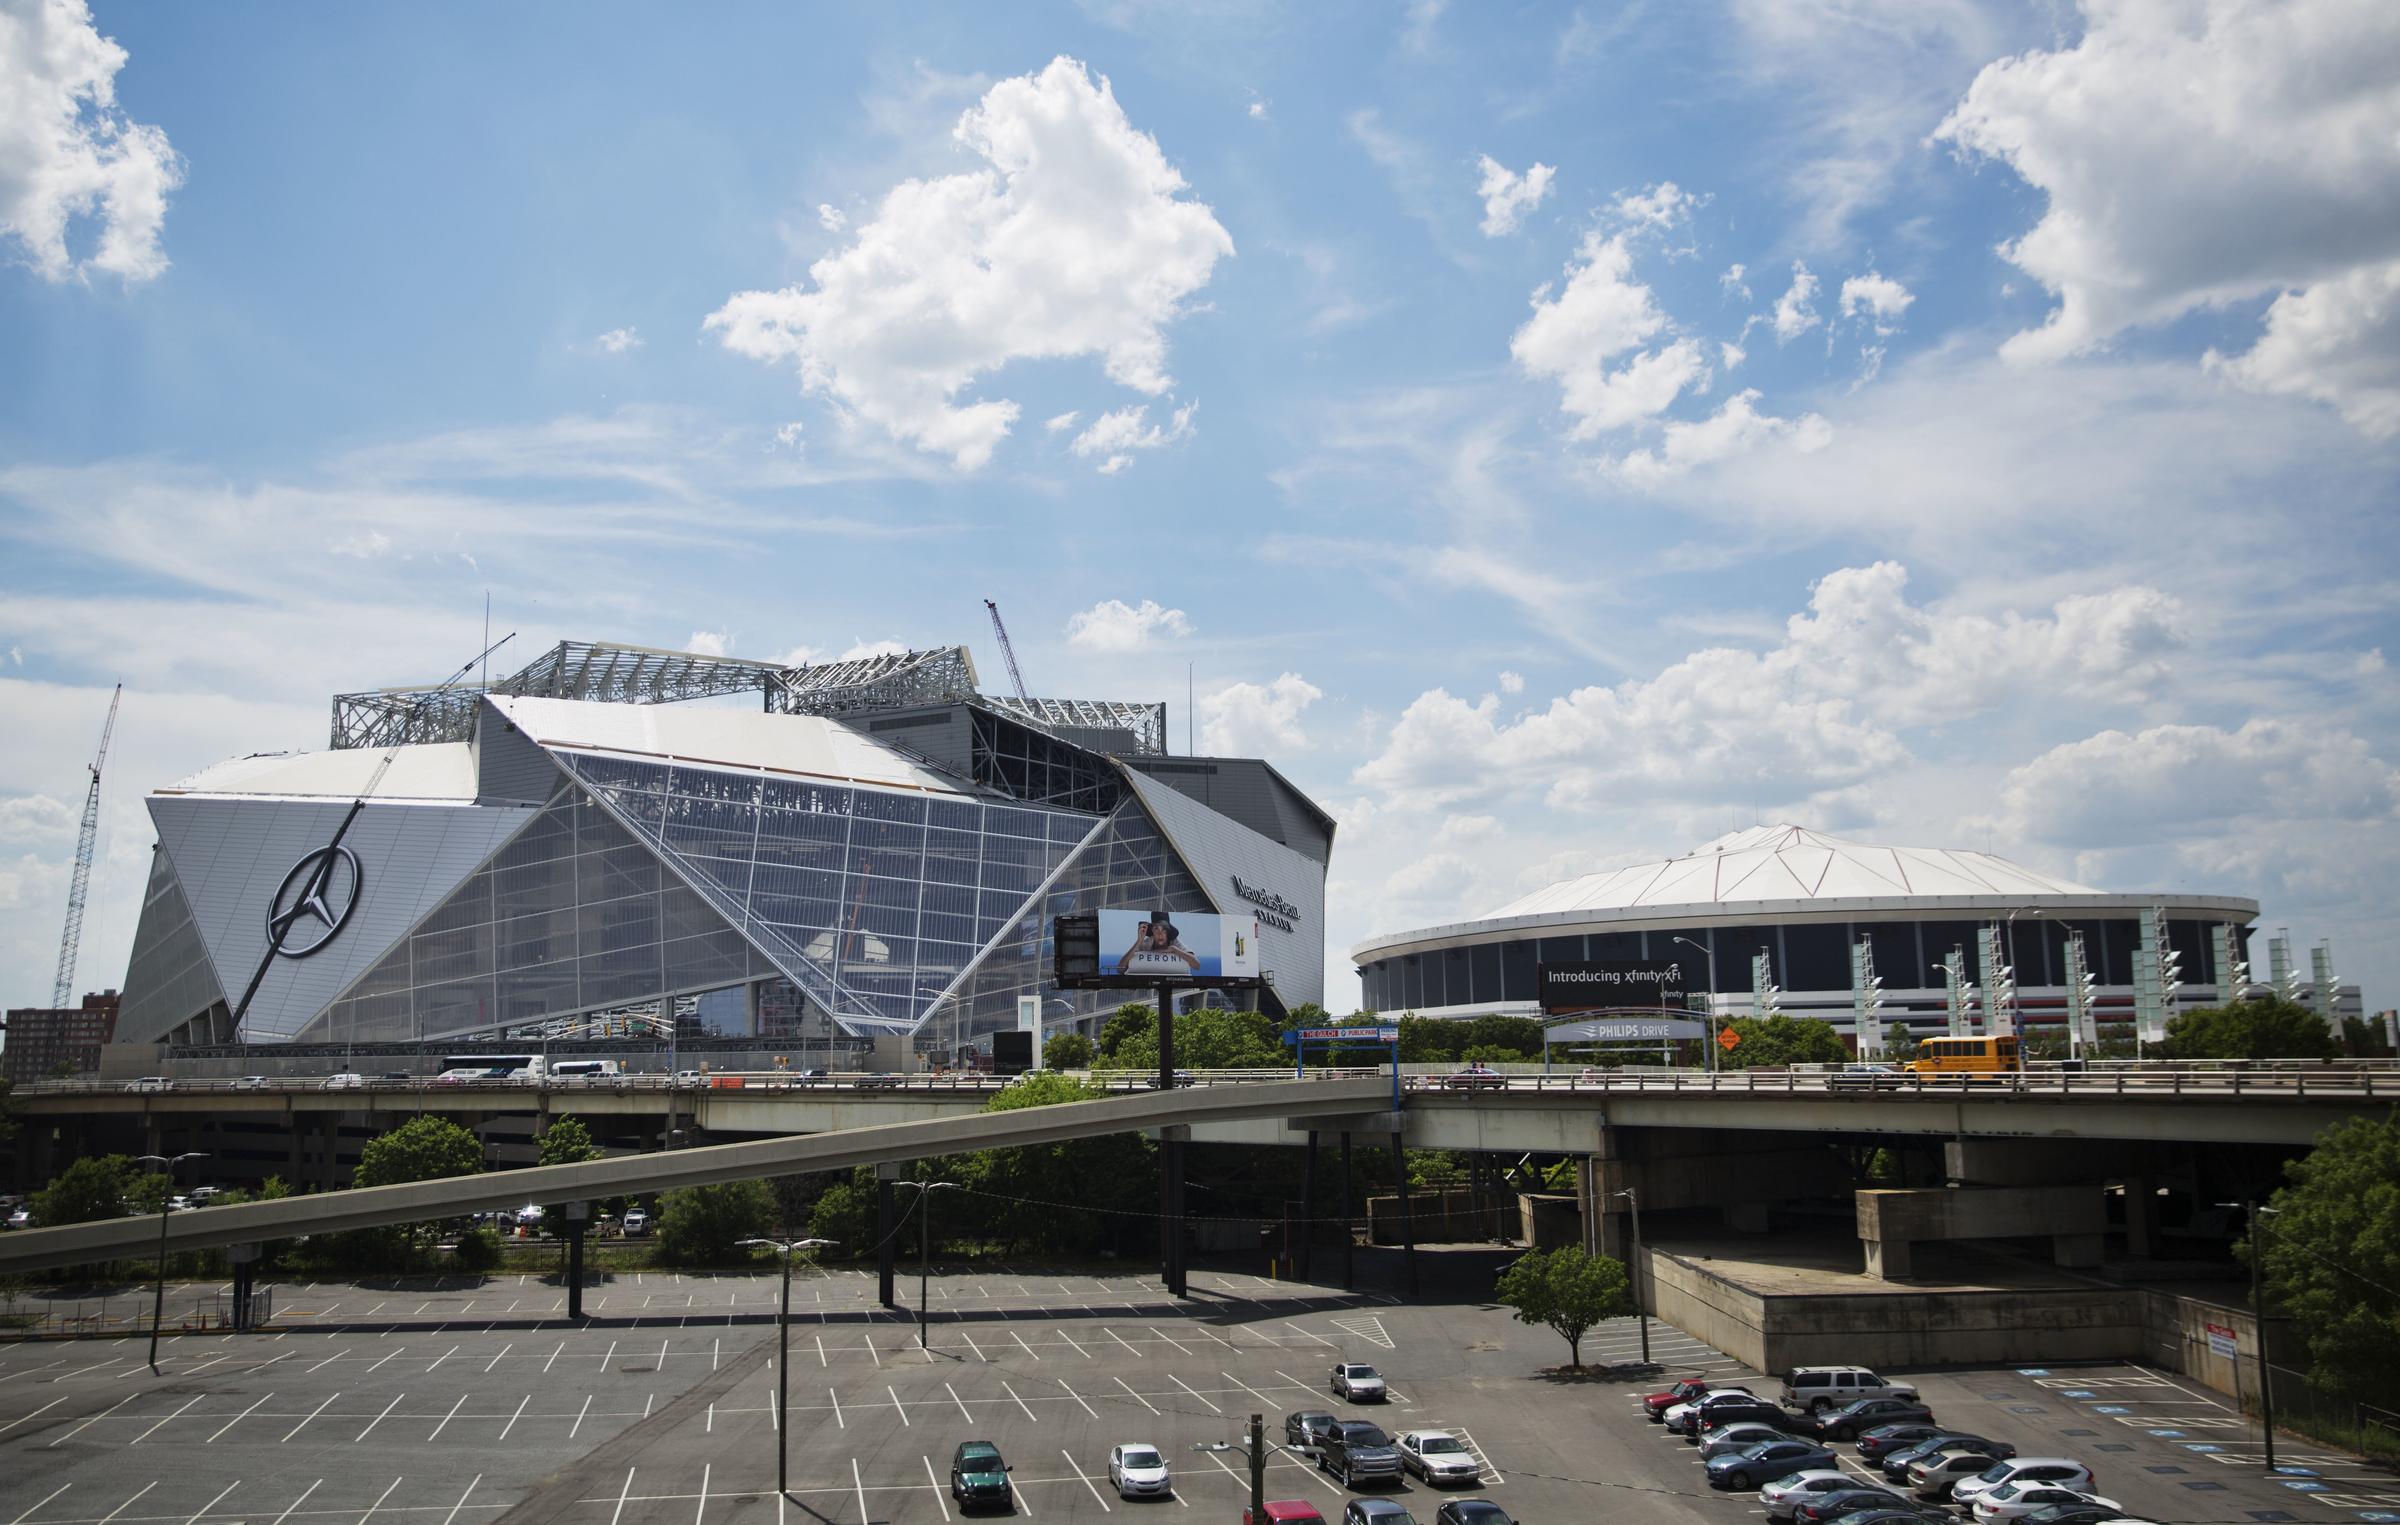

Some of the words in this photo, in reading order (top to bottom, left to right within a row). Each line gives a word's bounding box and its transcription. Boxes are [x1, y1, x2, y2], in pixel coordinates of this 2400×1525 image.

[1232, 874, 1301, 919] Mercedes-Benz
[1139, 953, 1182, 962] PERONI
[1549, 970, 1621, 984] Introducing
[1624, 970, 1661, 983] xfinity
[1664, 969, 1681, 982] xFi
[1317, 1030, 1336, 1038] GULCH
[1600, 1025, 1638, 1037] PHILIPS
[1642, 1025, 1669, 1036] DRIVE
